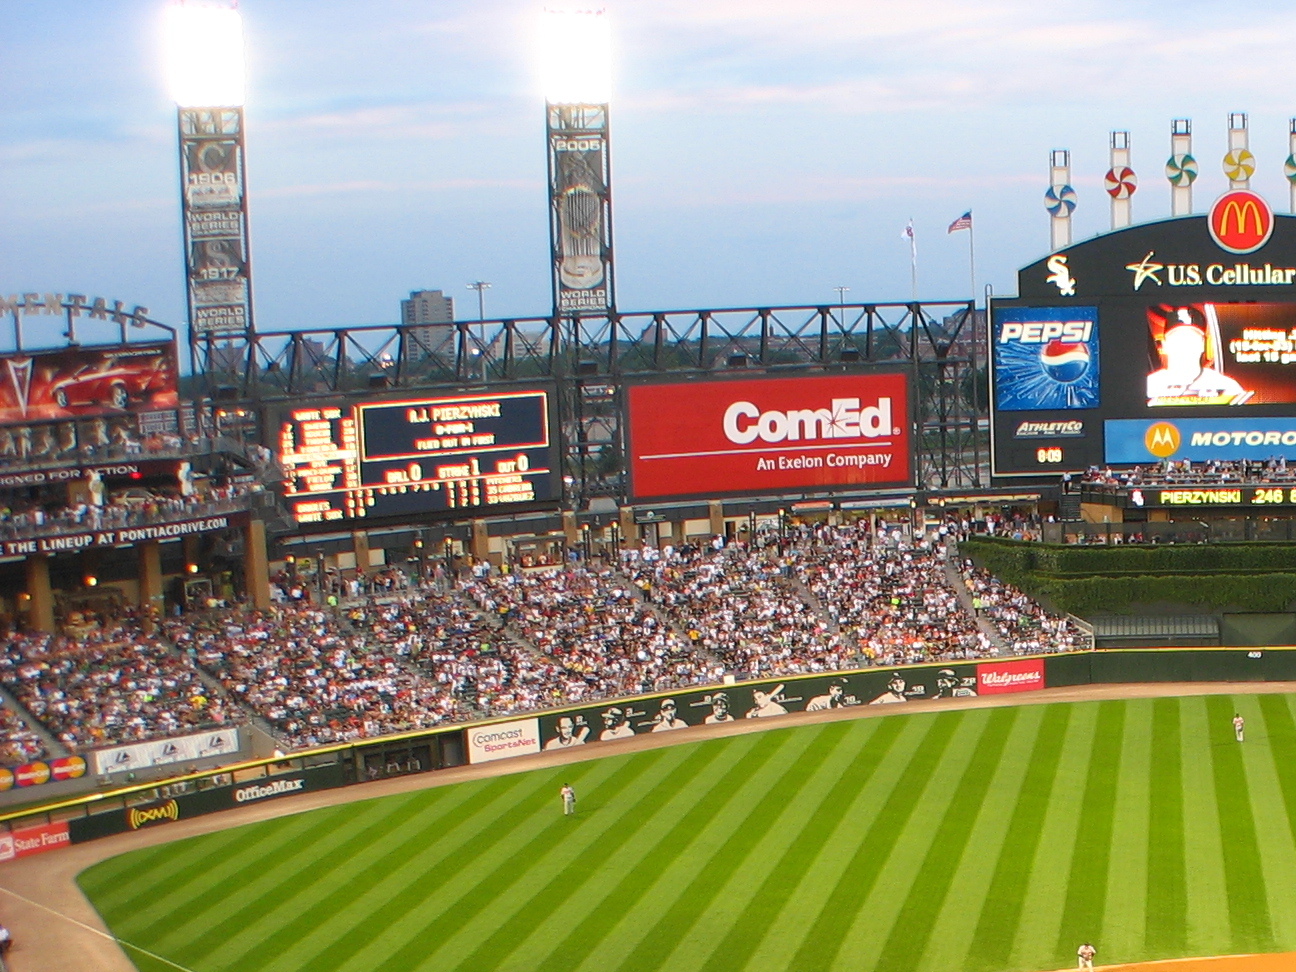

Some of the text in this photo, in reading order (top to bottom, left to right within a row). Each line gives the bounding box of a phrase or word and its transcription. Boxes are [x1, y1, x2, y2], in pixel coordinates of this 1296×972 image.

[189, 172, 236, 185] 1906
[192, 211, 239, 221] WORLD
[192, 220, 239, 230] SERIES
[200, 267, 240, 279] 1917
[1167, 263, 1203, 286] U.S.
[1206, 262, 1296, 286] Cellular
[560, 289, 606, 299] WORLD
[560, 298, 606, 306] SERIES
[196, 306, 244, 316] WORLD
[197, 316, 245, 325] SERIES
[1000, 321, 1093, 344] PEPSI
[408, 402, 501, 423] A.J. PIERZYNSKI
[723, 397, 893, 444] ComEd
[1017, 420, 1084, 432] ATHLETICO
[757, 452, 893, 471] An Exelon Company
[1036, 447, 1063, 463] 8:09
[437, 464, 471, 479] STRIKE
[497, 460, 517, 473] OUT
[49, 469, 81, 480] FOR
[385, 469, 410, 484] BALL
[1160, 490, 1242, 504] PIERZYNSKI
[1251, 489, 1284, 504] .246
[8, 540, 37, 554] THE
[41, 535, 93, 551] LINEUP
[98, 532, 116, 544] AT
[120, 518, 228, 543] PONTIACDRIVE.COM
[1247, 651, 1262, 659] 400
[981, 671, 1041, 686] Walgreens
[473, 728, 523, 746] comcast
[484, 738, 537, 753] SportsNet
[235, 779, 304, 803] OfficeMax
[14, 831, 70, 852] State Farm
